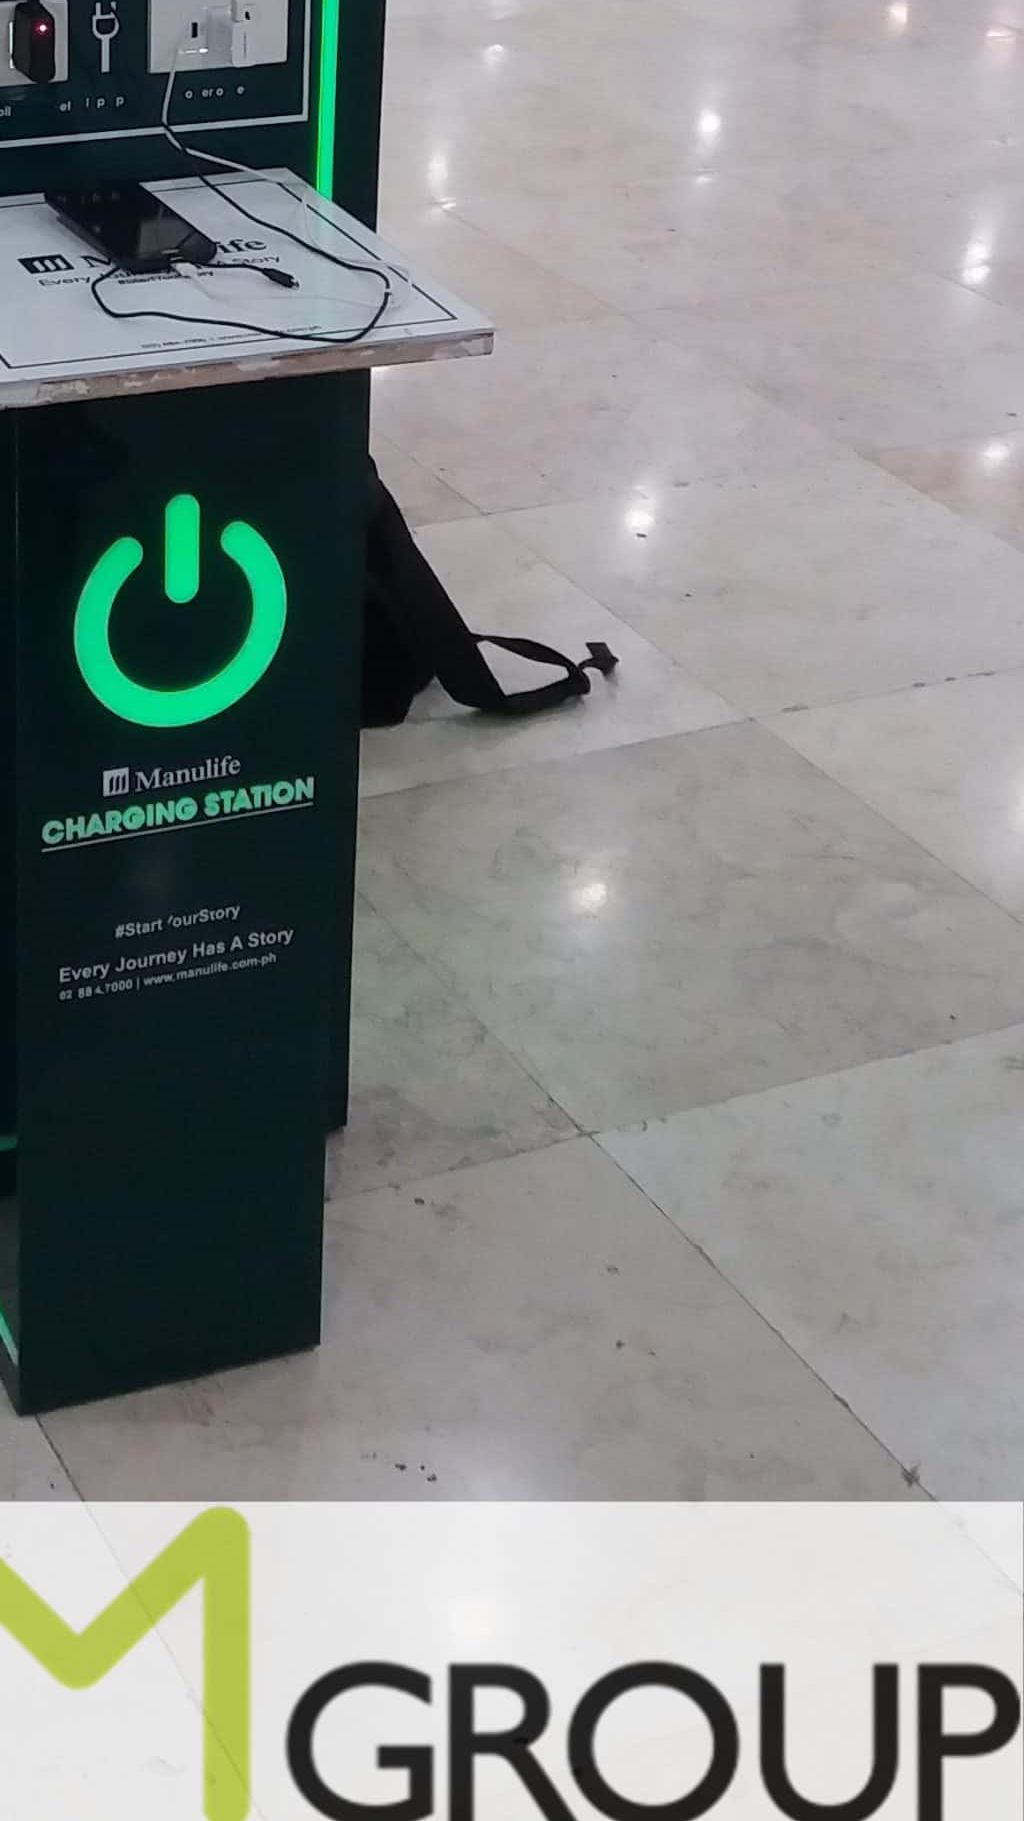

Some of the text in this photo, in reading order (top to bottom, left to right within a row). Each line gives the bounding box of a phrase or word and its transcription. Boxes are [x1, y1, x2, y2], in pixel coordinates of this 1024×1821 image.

[38, 275, 91, 288] Every
[134, 755, 242, 792] Manulife
[41, 776, 315, 845] CHARGING STATION
[58, 928, 294, 984] Every Journey Has A Story
